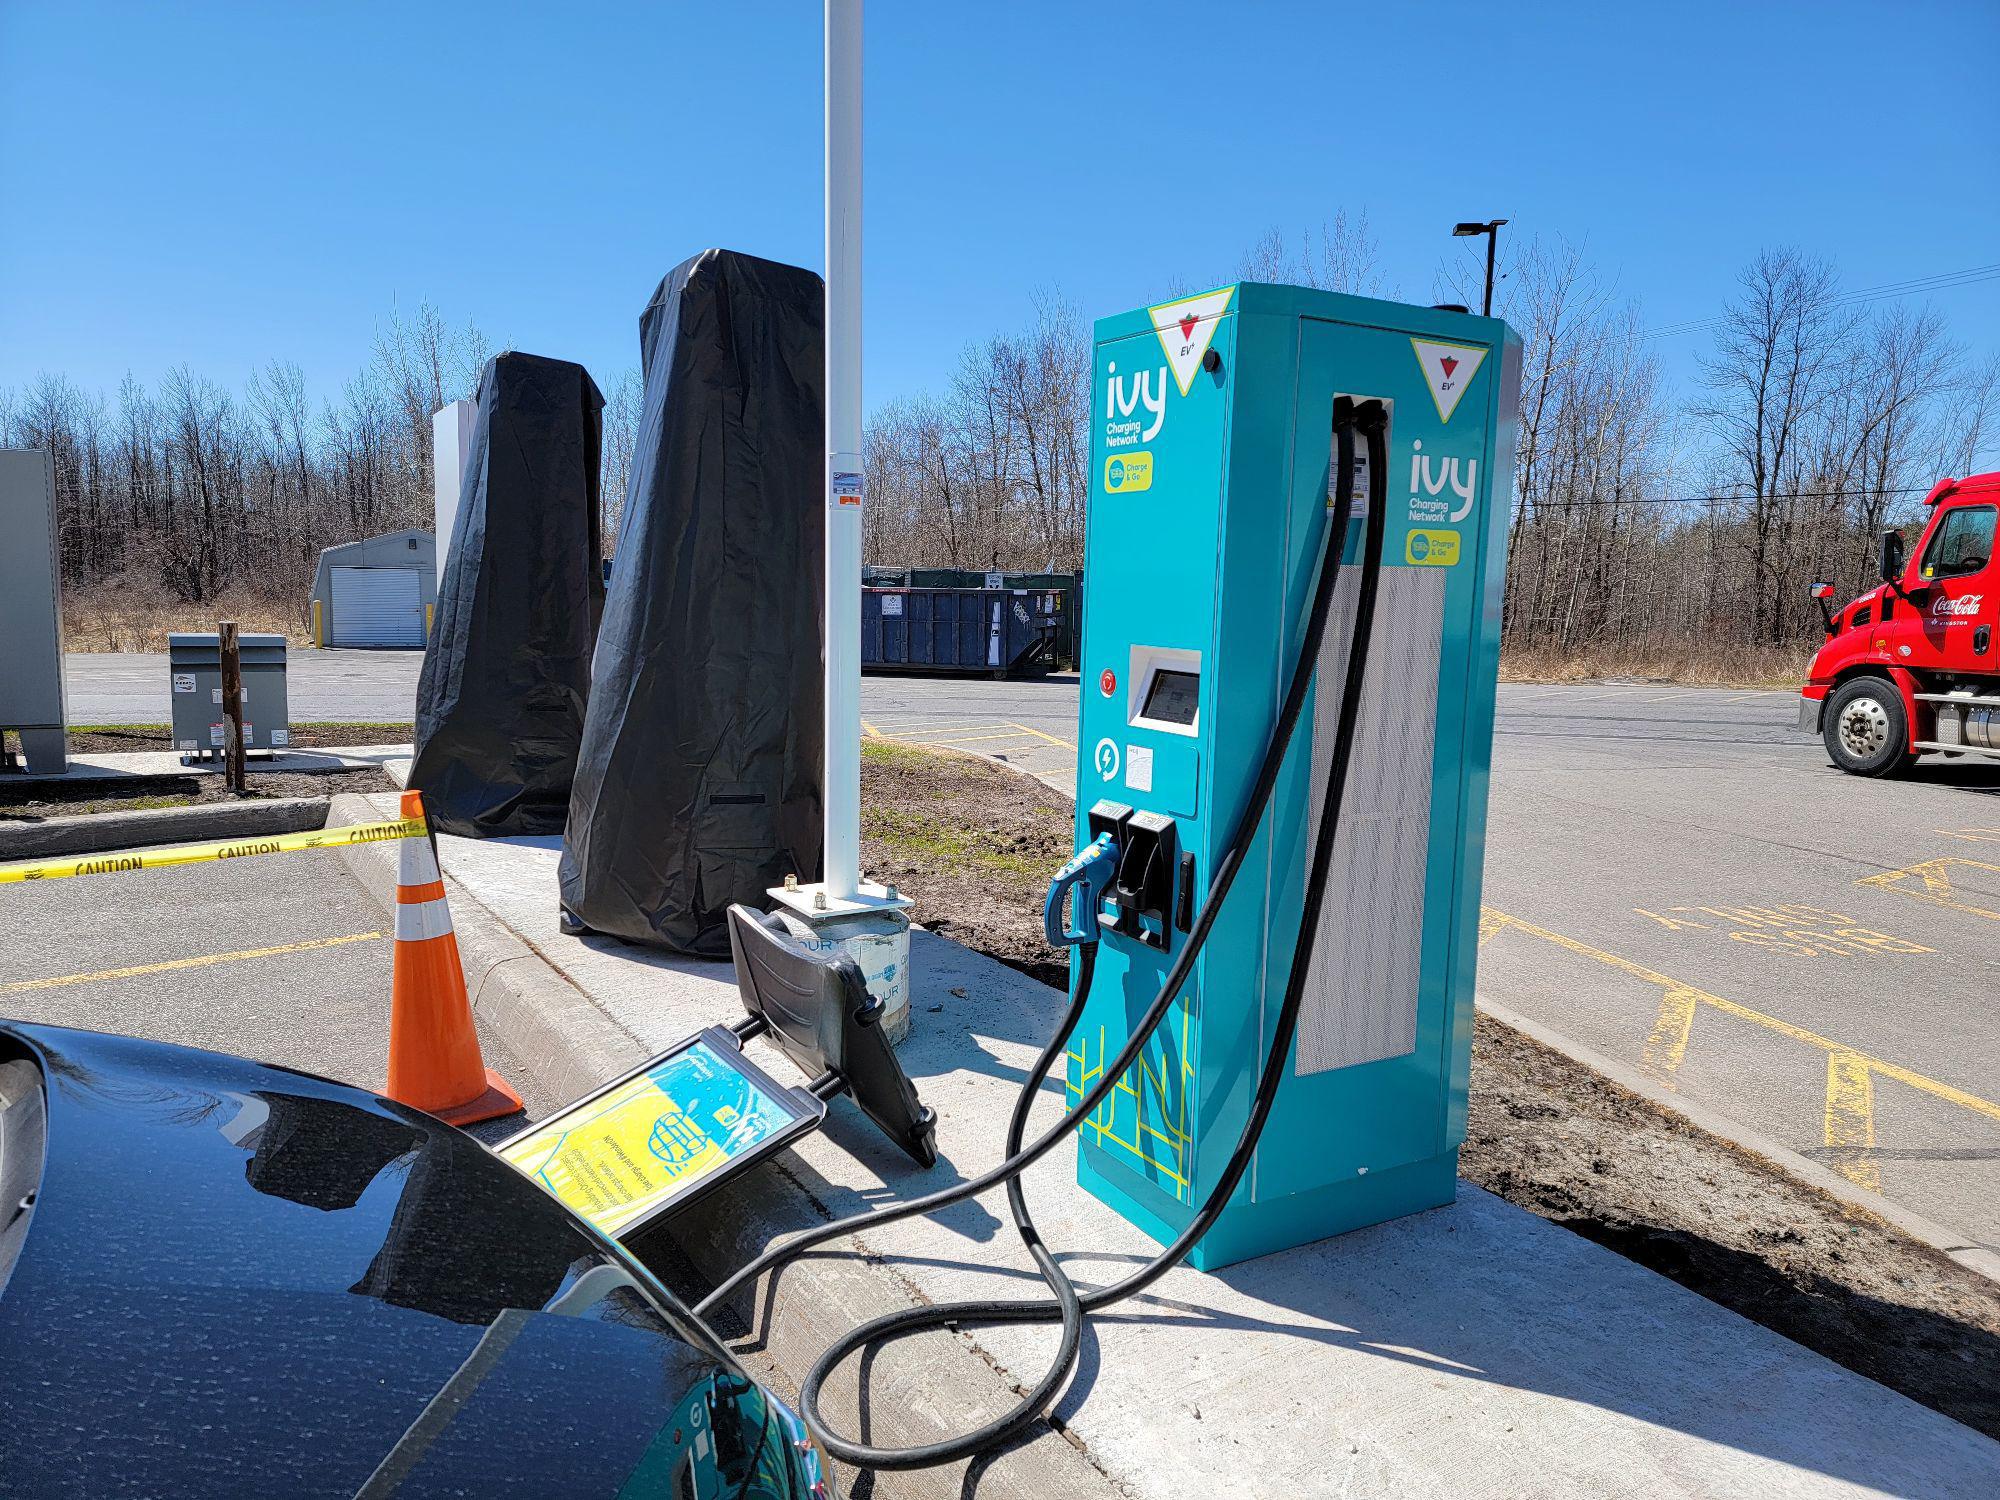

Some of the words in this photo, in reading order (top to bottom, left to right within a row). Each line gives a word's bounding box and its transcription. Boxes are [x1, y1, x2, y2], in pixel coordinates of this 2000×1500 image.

[1107, 361, 1167, 443] ivy
[1107, 420, 1140, 435] Charging
[1106, 433, 1138, 447] Network
[1127, 464, 1148, 473] Charge
[1410, 439, 1477, 522] ivy
[1409, 498, 1449, 512] Charging
[1408, 510, 1445, 522] Network
[1432, 540, 1456, 549] Charge
[350, 824, 408, 844] CAUTION
[217, 842, 281, 859] CAUTION
[75, 856, 143, 876] CAUTION
